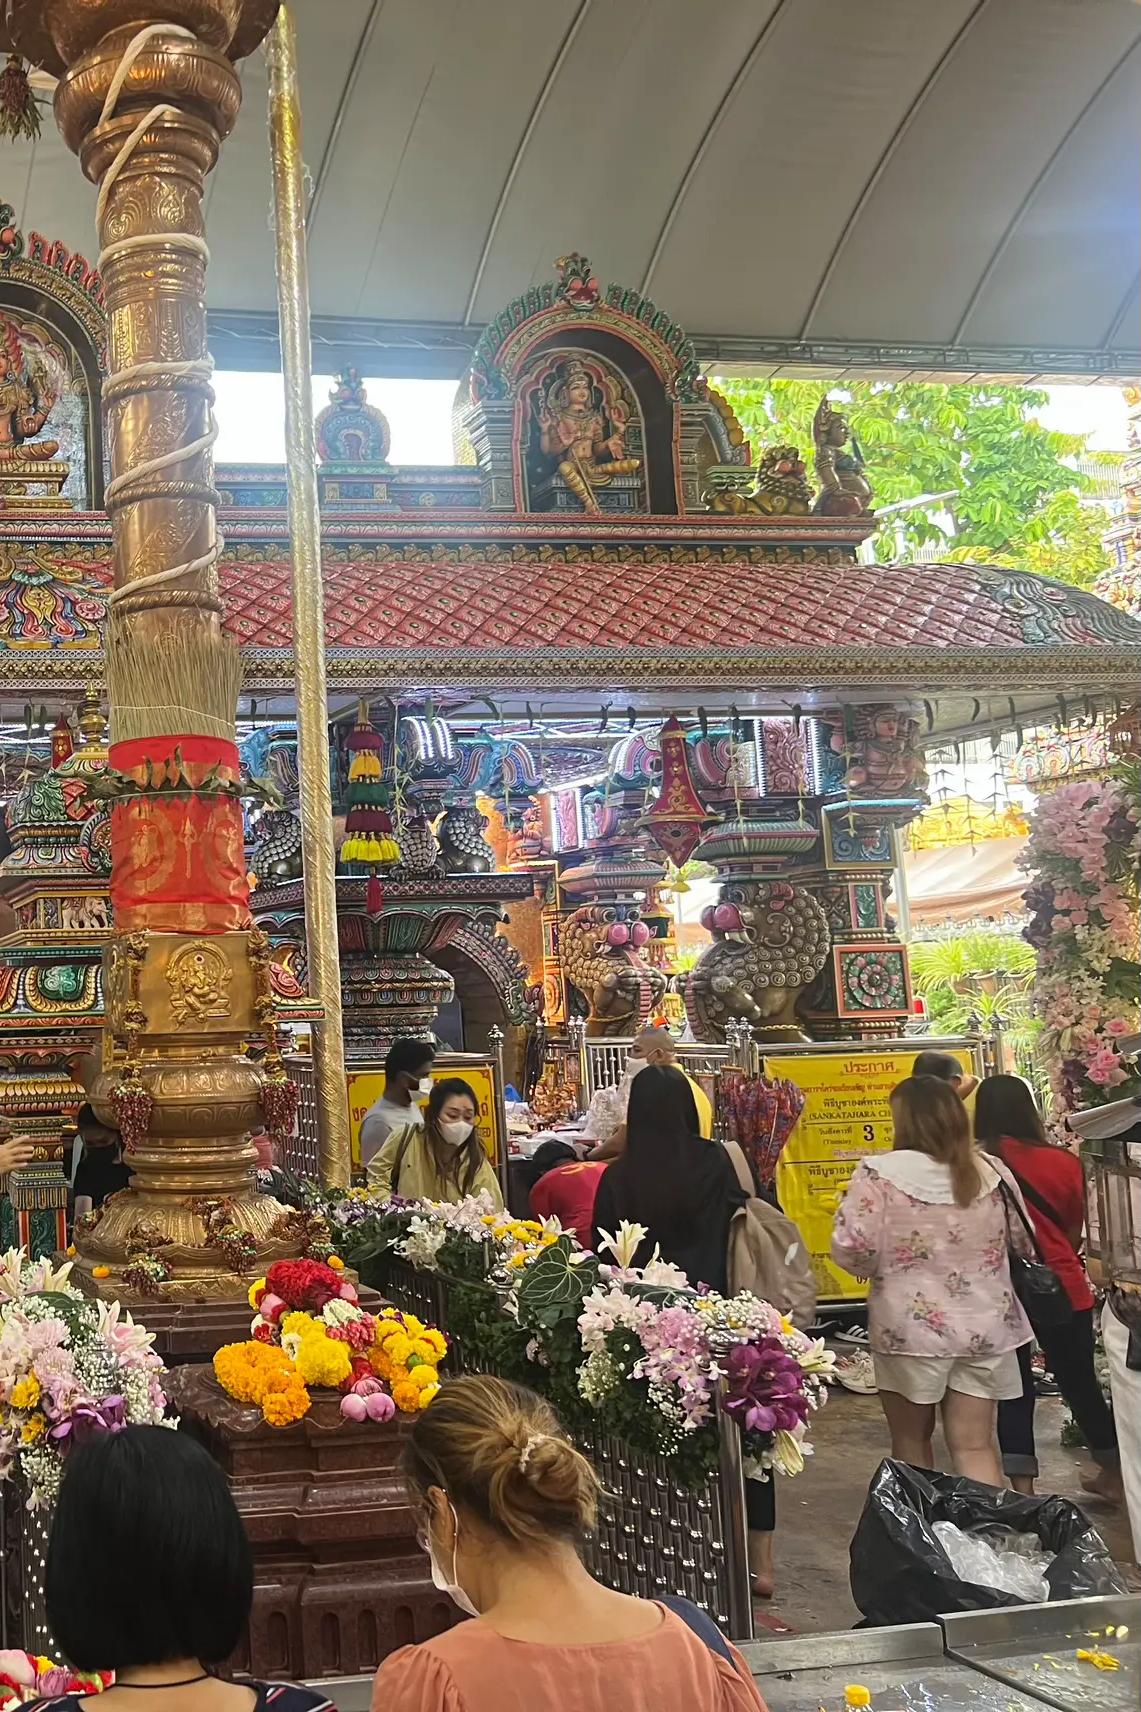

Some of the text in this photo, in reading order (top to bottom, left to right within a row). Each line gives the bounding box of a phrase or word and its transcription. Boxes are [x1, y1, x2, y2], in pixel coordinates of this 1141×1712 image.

[843, 1061, 894, 1073] ประกาศ
[863, 1124, 875, 1142] 3
